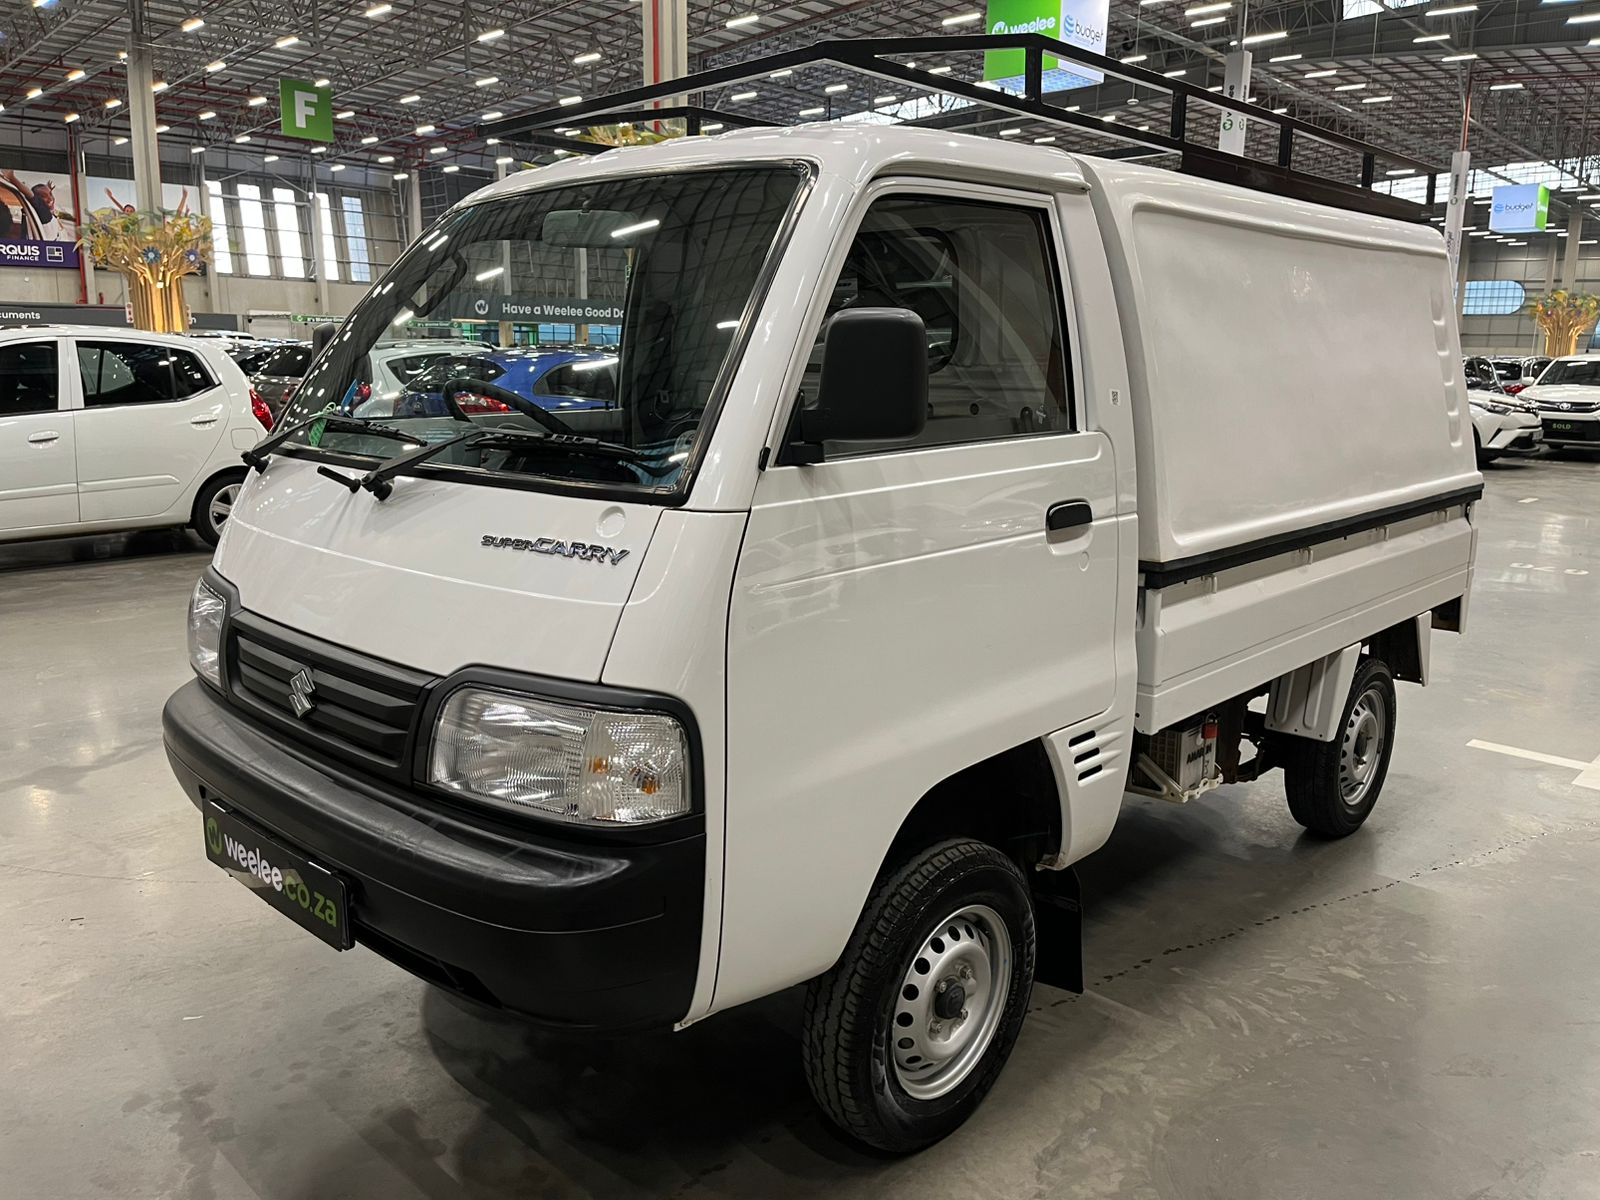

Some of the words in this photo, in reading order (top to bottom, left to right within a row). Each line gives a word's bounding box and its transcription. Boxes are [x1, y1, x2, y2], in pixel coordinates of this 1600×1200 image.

[1075, 19, 1104, 45] budget
[294, 90, 318, 128] F
[502, 303, 531, 315] Have
[534, 307, 541, 315] a
[543, 305, 582, 317] Weelee
[585, 307, 611, 318] Good
[224, 833, 337, 927] weelee.co.za
